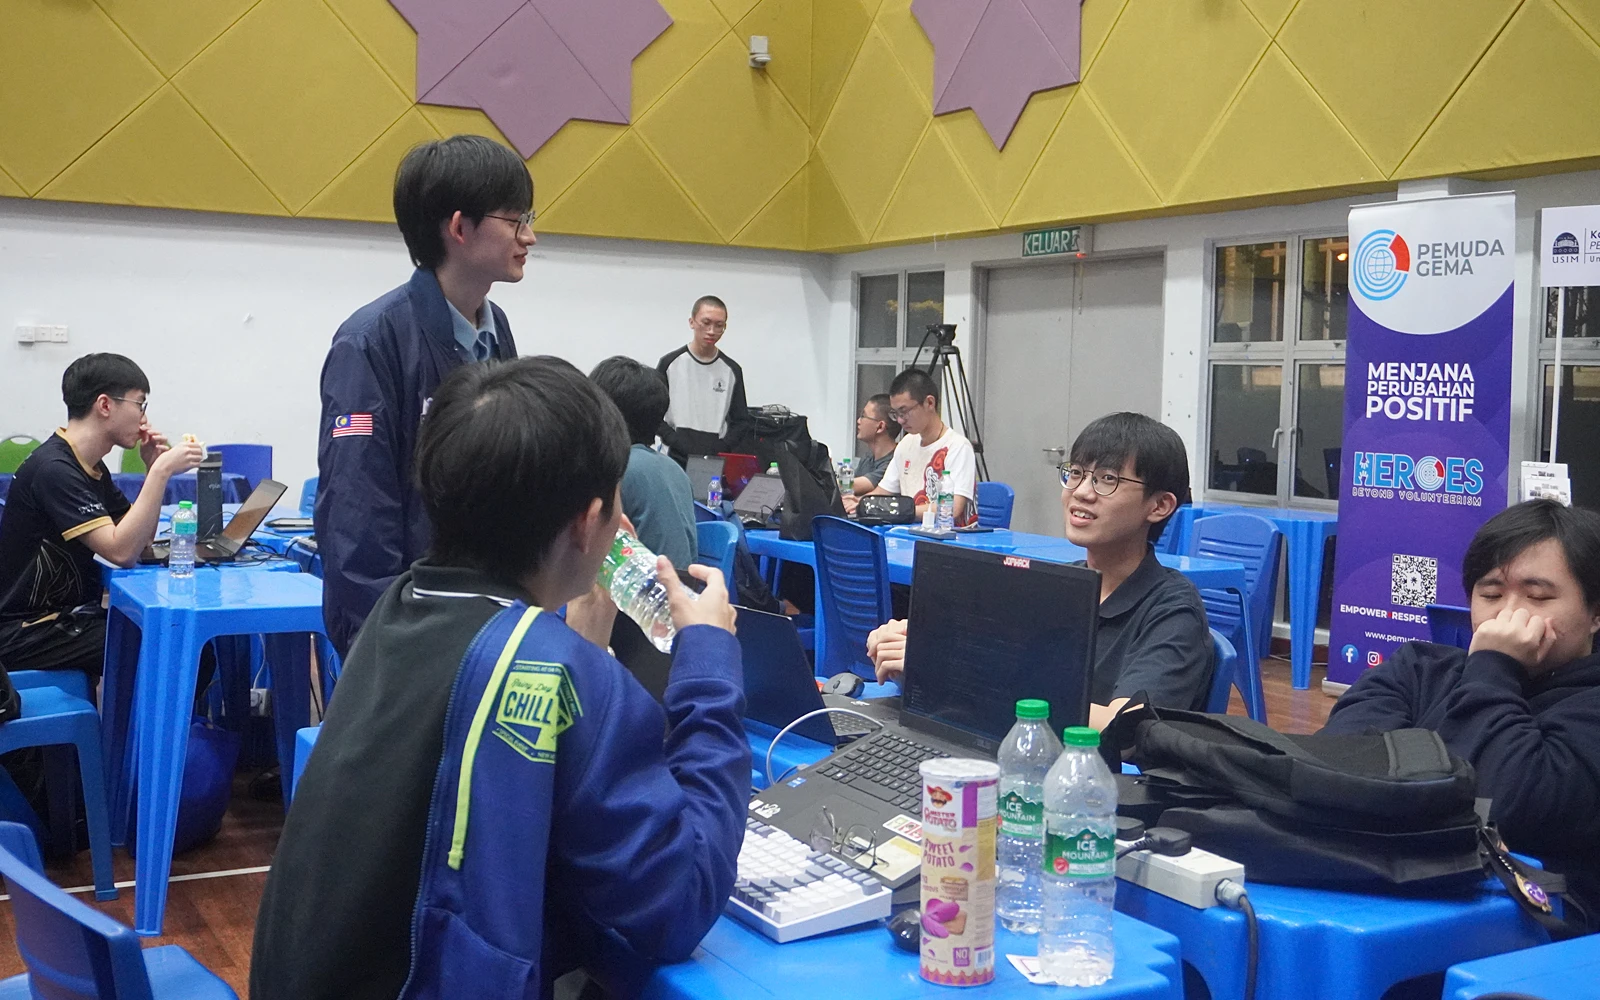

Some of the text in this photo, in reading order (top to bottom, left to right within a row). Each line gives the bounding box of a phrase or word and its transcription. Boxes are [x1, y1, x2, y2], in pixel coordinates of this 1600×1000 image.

[1024, 230, 1070, 255] KELUAR
[1417, 239, 1505, 260] PEMUDA
[1416, 259, 1474, 277] GEMA
[1552, 255, 1579, 264] USIM
[1367, 362, 1475, 382] MENJANA
[1367, 380, 1475, 398] PERUBAHAN
[1365, 396, 1475, 422] POSITIF
[1353, 451, 1484, 495] HEROES
[1352, 487, 1482, 506] BEYOND VOLUNTEERISM
[1340, 604, 1428, 625] EMPOWER RESPEC
[503, 691, 553, 724] CHILL
[1006, 800, 1022, 812] ICE
[1077, 840, 1097, 851] ICE
[924, 849, 955, 868] POTATO
[1062, 850, 1108, 861] MOUNTAIN
